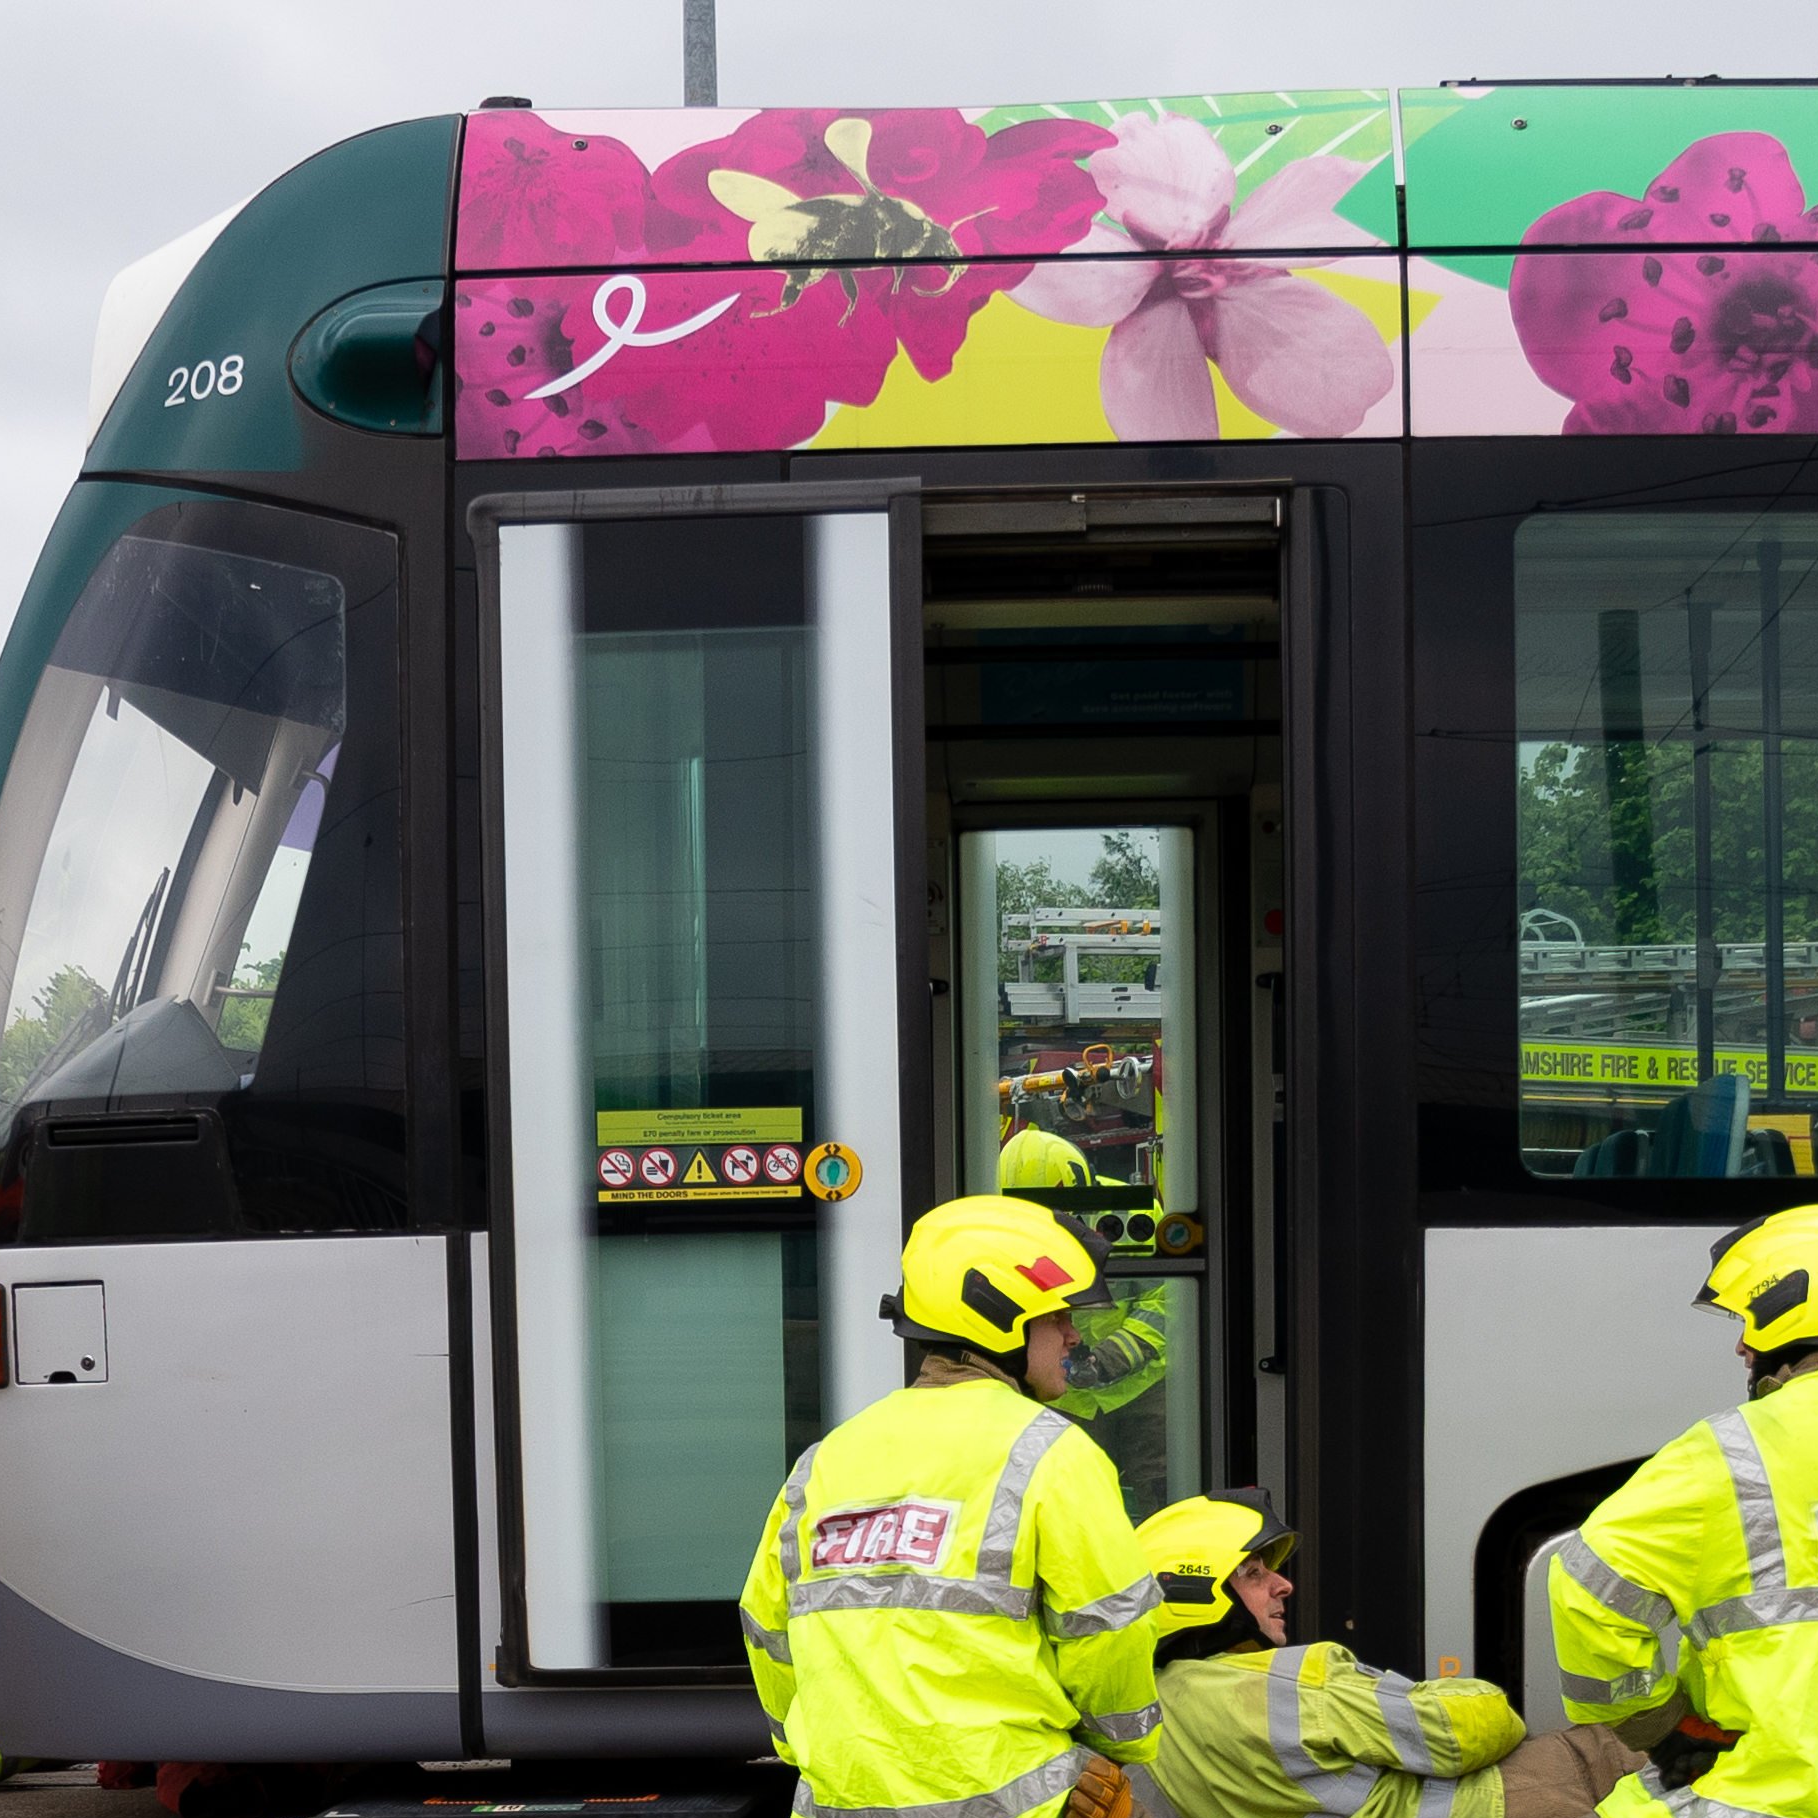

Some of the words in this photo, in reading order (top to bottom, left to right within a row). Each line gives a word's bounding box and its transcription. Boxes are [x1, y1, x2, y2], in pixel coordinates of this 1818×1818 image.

[164, 354, 244, 408] 208
[1522, 1051, 1593, 1077] MSHIRE
[1600, 1053, 1639, 1079] FIRE
[1646, 1056, 1659, 1080] &
[1667, 1057, 1737, 1081] RESUE
[657, 1112, 701, 1121] Compulsory
[659, 1130, 685, 1138] penalty
[713, 1128, 756, 1137] prosecution
[610, 1191, 635, 1200] MIND
[636, 1191, 655, 1199] THE
[656, 1190, 689, 1199] DOORS
[816, 1509, 941, 1559] FIRE
[1178, 1564, 1210, 1575] 2645
